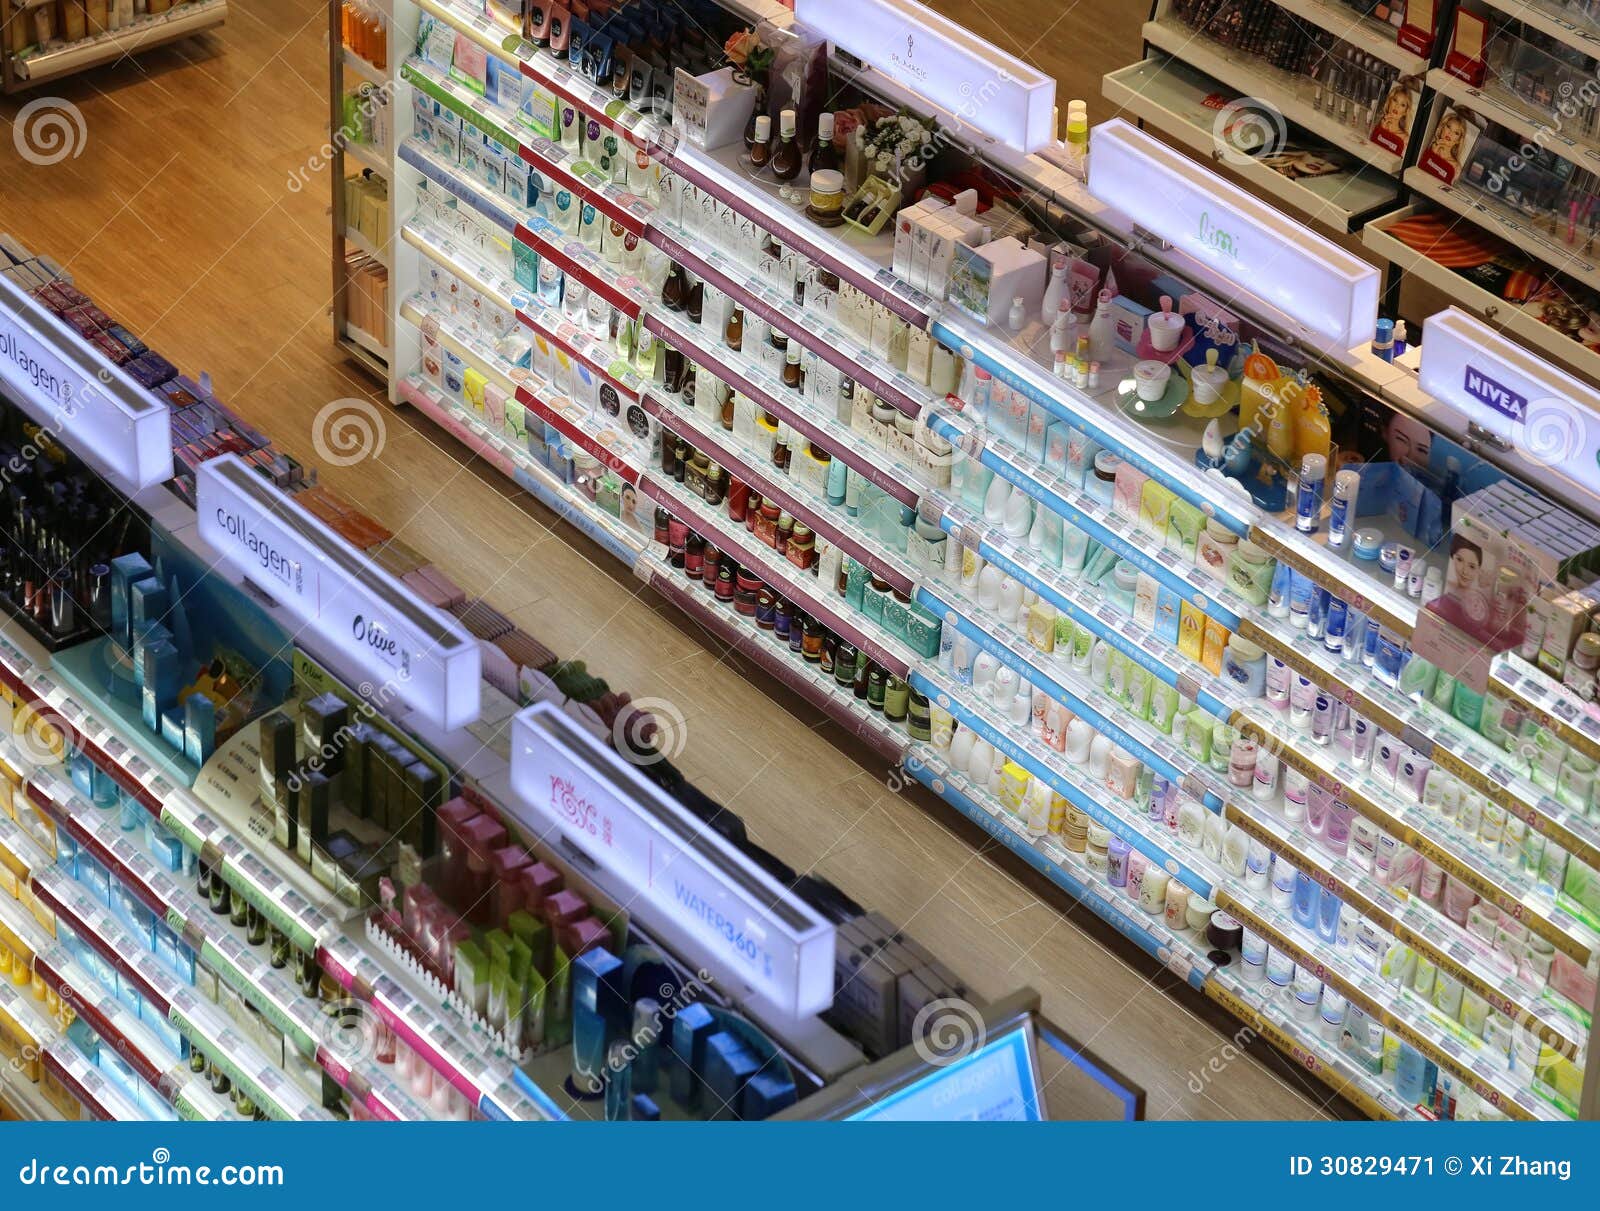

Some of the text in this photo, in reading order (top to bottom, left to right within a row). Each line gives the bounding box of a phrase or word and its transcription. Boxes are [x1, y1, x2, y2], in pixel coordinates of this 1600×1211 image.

[0, 333, 61, 398] ollagen
[1468, 371, 1524, 418] NIVEA
[216, 507, 291, 580] collagen
[352, 614, 397, 656] Olive
